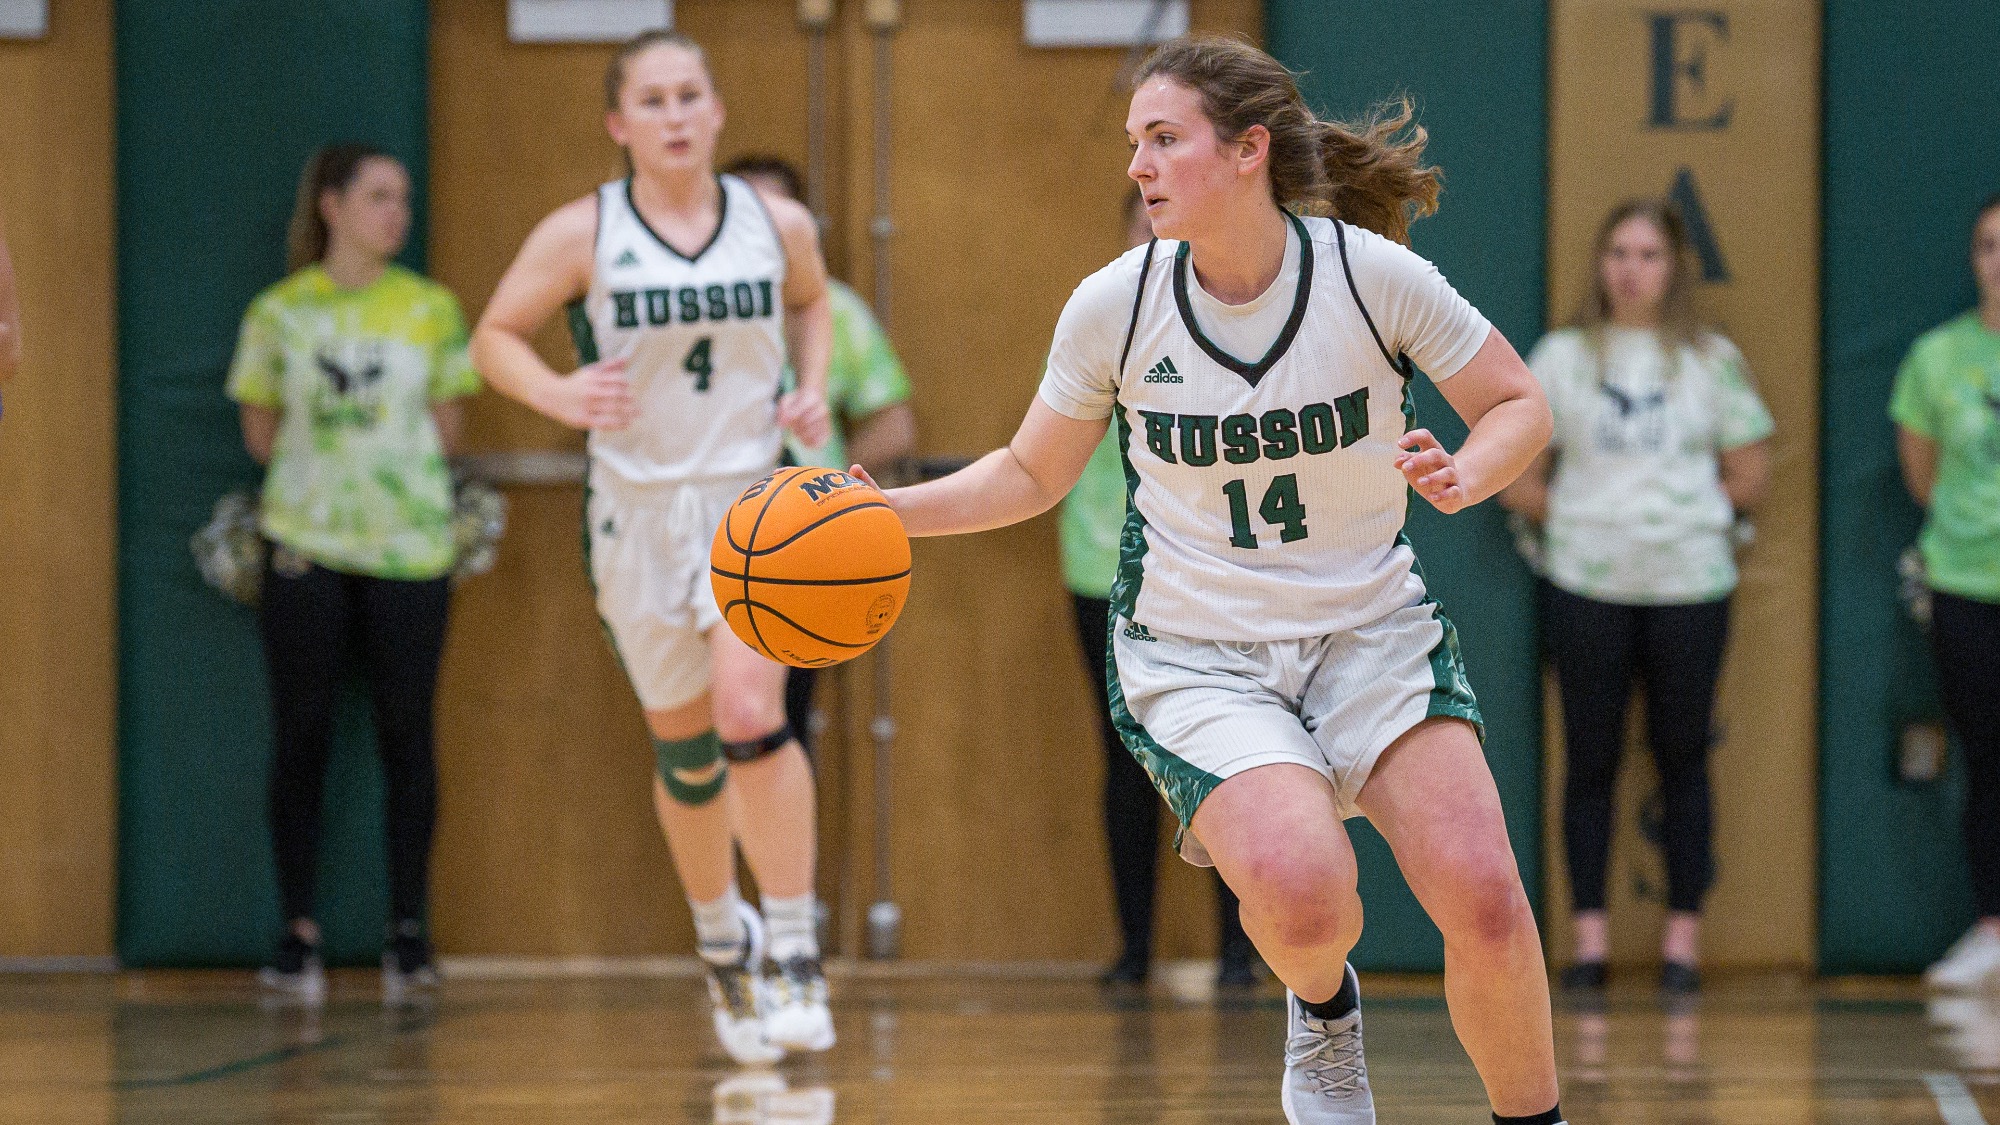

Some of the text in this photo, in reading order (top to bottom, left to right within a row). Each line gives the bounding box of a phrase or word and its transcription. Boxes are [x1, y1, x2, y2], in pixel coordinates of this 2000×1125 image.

[683, 337, 713, 392] 4
[1144, 372, 1184, 384] adidas
[1137, 386, 1370, 467] HUSSON
[798, 472, 869, 502] NCA
[1222, 472, 1309, 549] 14
